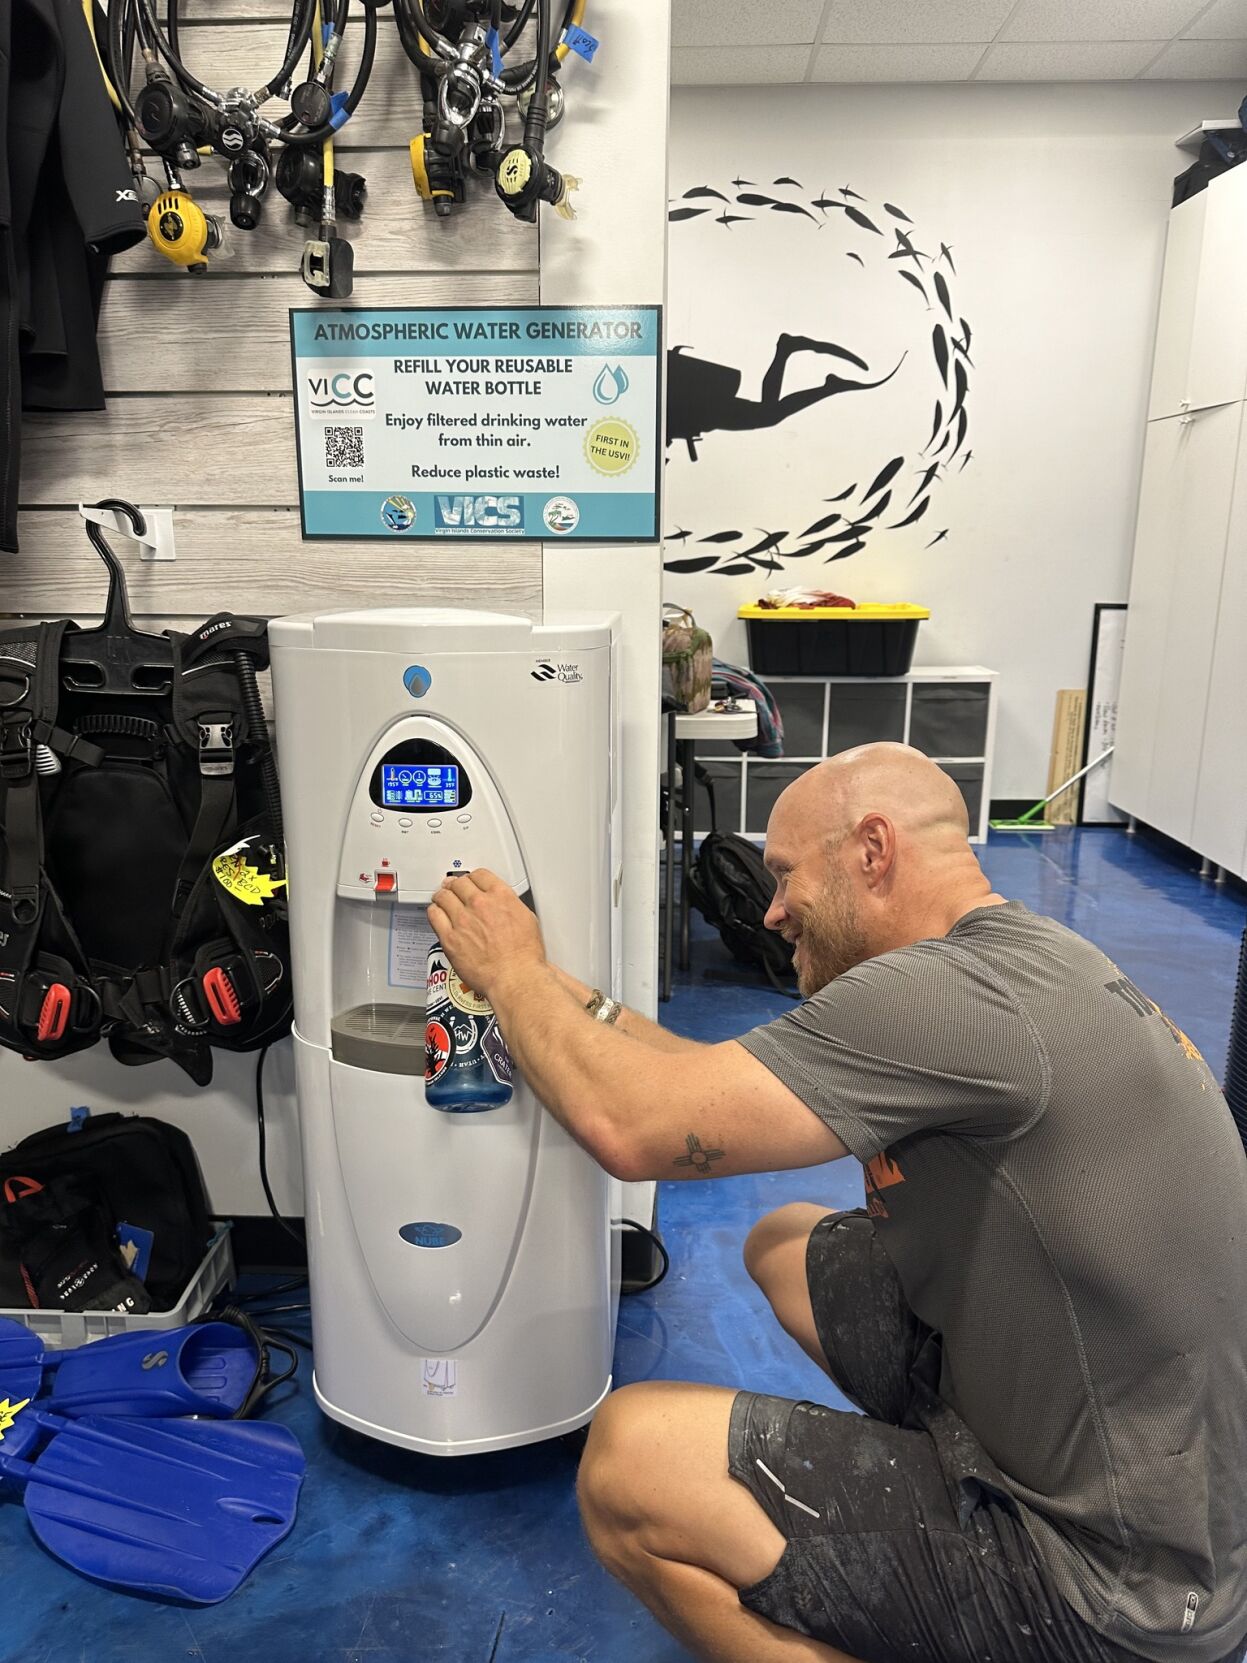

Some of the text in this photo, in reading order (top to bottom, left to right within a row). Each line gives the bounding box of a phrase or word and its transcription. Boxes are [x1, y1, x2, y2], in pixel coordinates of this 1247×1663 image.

[314, 321, 643, 340] ATMOSPHERIC WATER GENERATOR
[394, 358, 573, 373] REFILL YOUR REUSABLE
[308, 373, 374, 399] VICC
[425, 381, 542, 395] WATER BOTTLE
[385, 413, 588, 430] Enjoy filtered drinking water
[438, 433, 532, 447] from thin air.
[595, 434, 630, 449] FIRST IN
[590, 446, 631, 462] THE USVI!
[328, 474, 364, 483] Scan me!
[411, 465, 560, 482] Reduce plastic waste!
[437, 496, 521, 526] VICS
[200, 621, 233, 640] mares
[557, 664, 579, 672] Water
[557, 672, 584, 683] Quality
[427, 970, 447, 988] HOO
